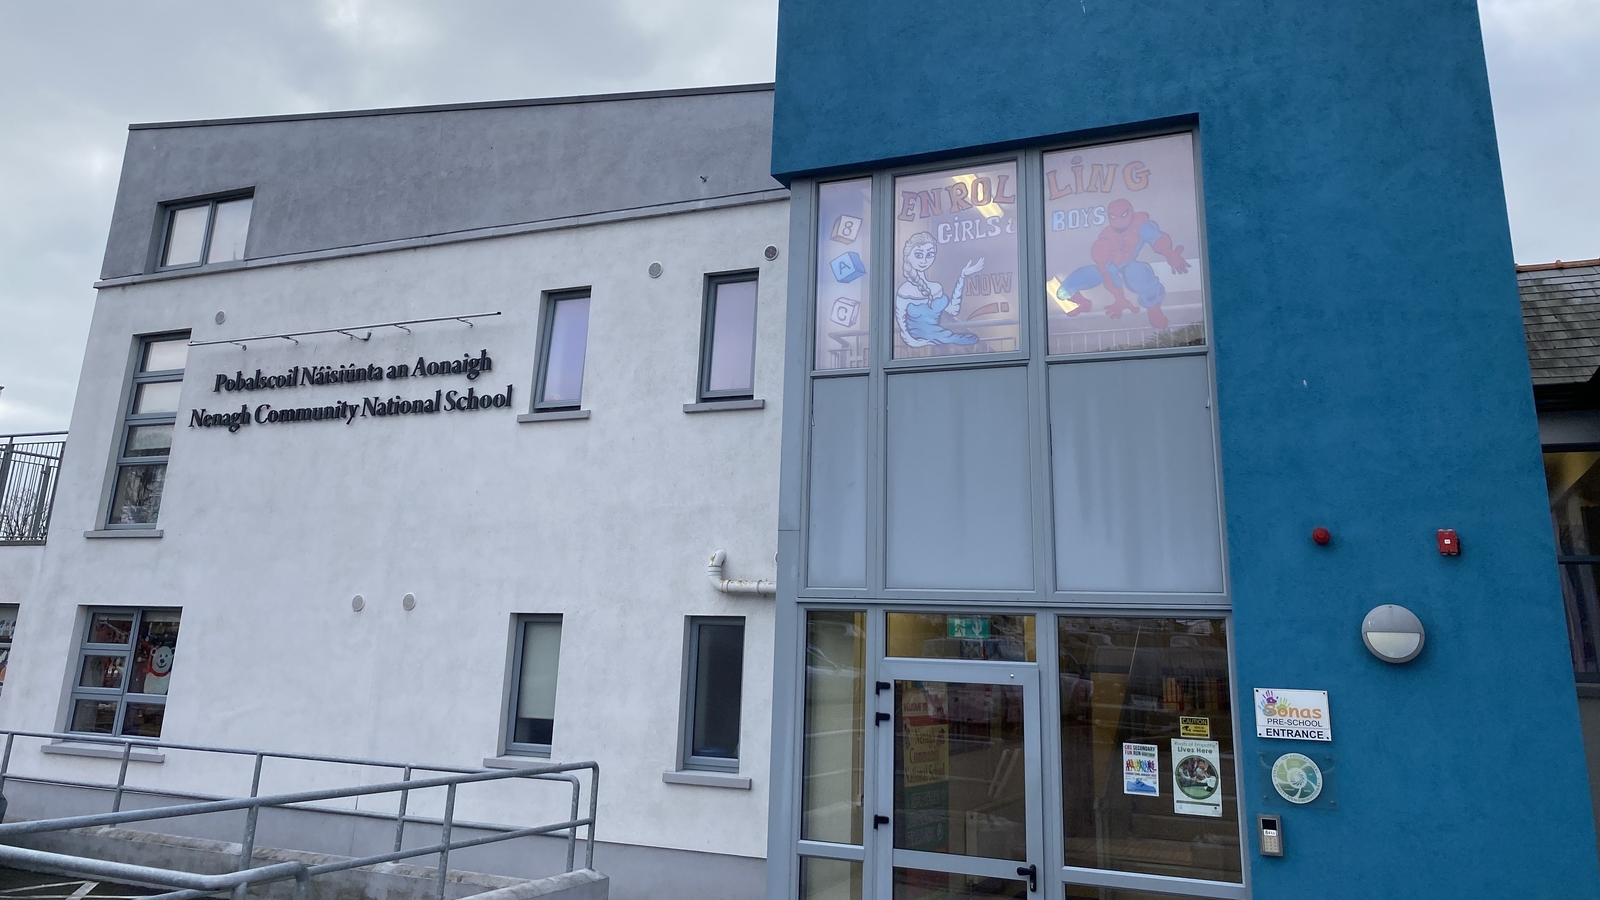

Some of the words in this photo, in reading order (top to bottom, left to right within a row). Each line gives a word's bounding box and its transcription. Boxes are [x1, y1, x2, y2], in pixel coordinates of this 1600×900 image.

[1052, 205, 1106, 232] BOYS
[838, 260, 851, 275] A
[965, 271, 1013, 297] NOW
[836, 306, 848, 321] C
[212, 366, 299, 393] Pobalscoil
[299, 363, 383, 387] Náisiúnta
[385, 366, 409, 379] an
[410, 349, 492, 381] Aonaigh
[188, 404, 252, 433] Nenagh
[254, 400, 359, 426] Community
[360, 389, 442, 417] National
[443, 384, 514, 412] School
[1263, 703, 1322, 719] Sonas
[1267, 717, 1323, 727] PRE-SCHOOL
[1265, 728, 1324, 739] ENTRANCE
